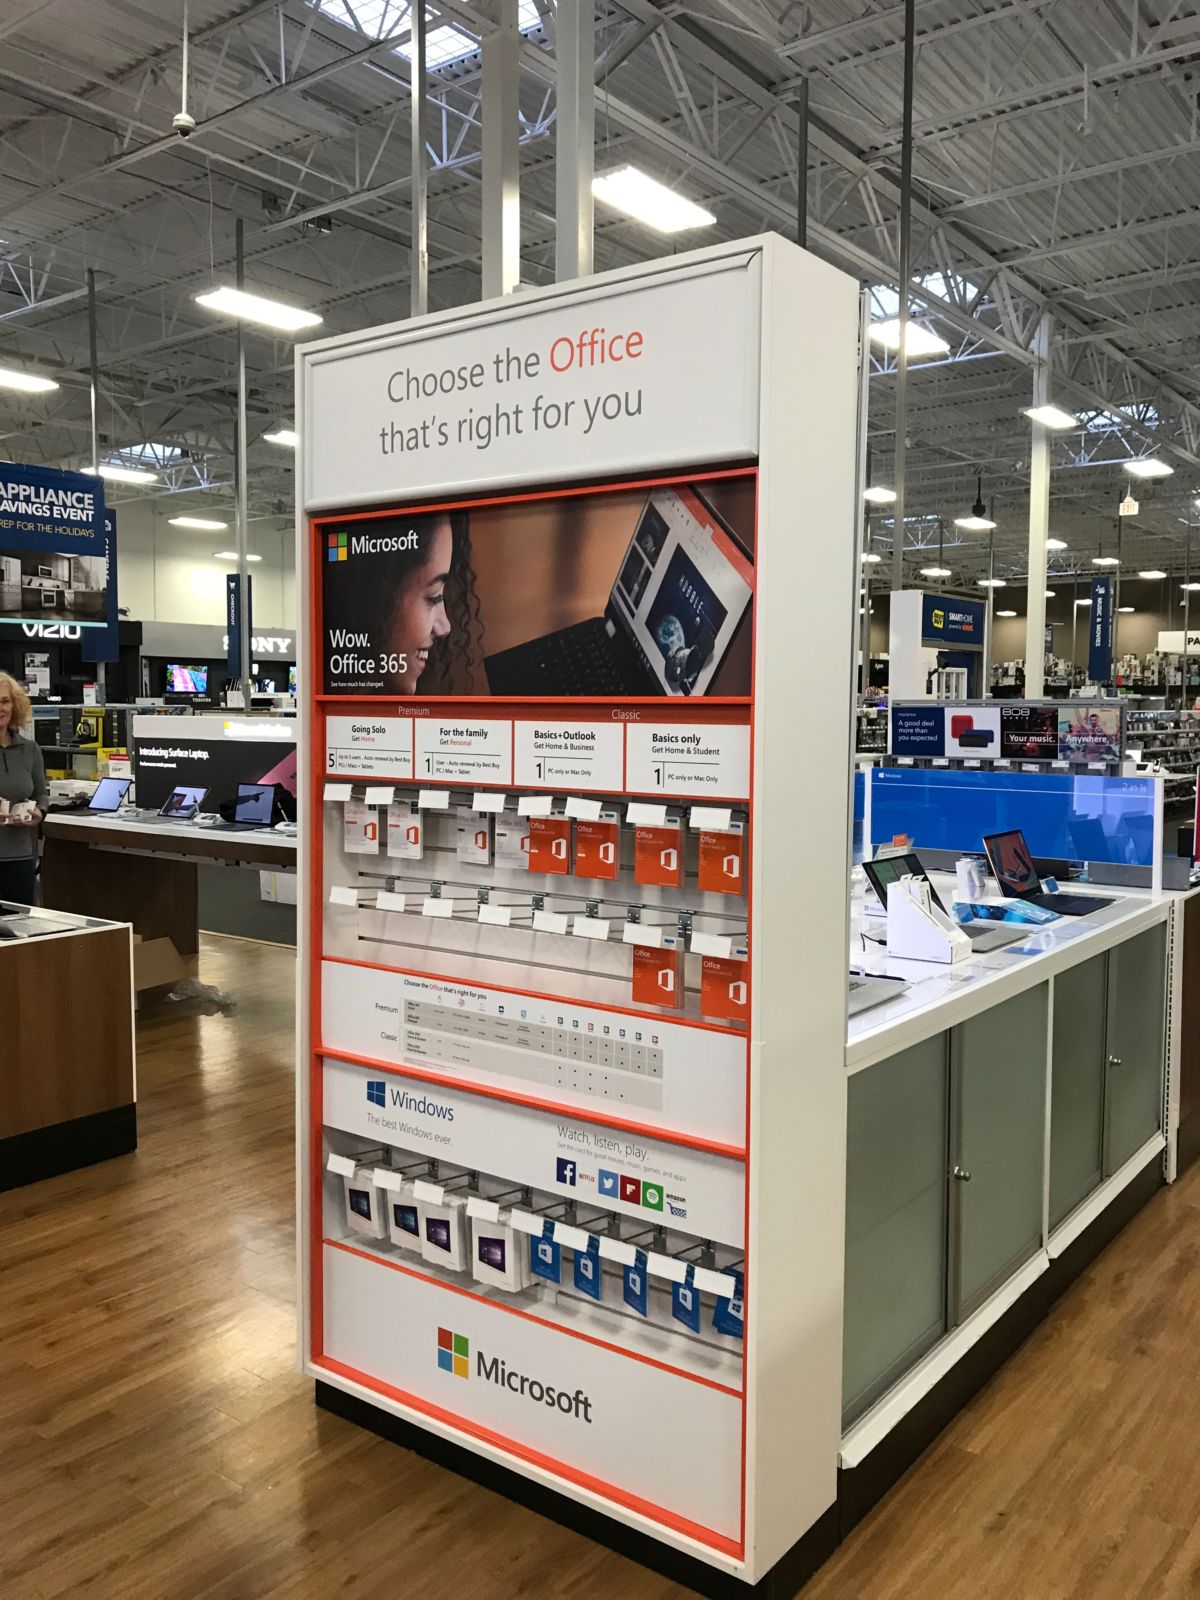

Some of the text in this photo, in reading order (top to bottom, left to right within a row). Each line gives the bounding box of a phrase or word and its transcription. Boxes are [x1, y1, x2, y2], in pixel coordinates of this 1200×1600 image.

[387, 327, 644, 403] Choose the Office
[379, 389, 642, 455] that's right for you
[0, 482, 95, 510] APPLIANCE
[0, 500, 95, 523] AVINGS EVENT
[0, 518, 95, 539] REP FOR THE HOLIDAYS
[351, 529, 419, 555] Microsoft
[21, 622, 81, 640] VIZIO
[329, 628, 371, 648] Wow.
[330, 653, 408, 674] Office 365
[398, 706, 430, 716] Premium
[611, 708, 641, 720] Classic
[351, 724, 386, 735] Going Solo
[904, 720, 920, 728] good
[439, 727, 489, 740] For the family
[534, 730, 596, 741] Basics+Outlook
[652, 733, 701, 746] Basics only
[910, 734, 938, 742] expected
[1009, 734, 1056, 743] Your music.
[439, 738, 472, 746] Get Personal
[533, 741, 544, 749] Get
[545, 742, 563, 750] Home
[569, 743, 595, 751] Business
[139, 747, 169, 759] Introducing
[168, 747, 189, 758] Surface
[651, 745, 720, 756] Get Home & Student
[328, 753, 335, 768] 5
[425, 757, 431, 773] 1
[535, 762, 542, 779] 1
[580, 769, 592, 777] Only
[654, 768, 661, 785] 1
[675, 774, 687, 782] only
[705, 775, 719, 784] Only
[530, 822, 546, 830] Office
[577, 825, 593, 833] Office
[636, 830, 653, 839] Office
[700, 835, 717, 844] Office
[634, 949, 651, 958] Office
[703, 960, 721, 970] Office
[403, 978, 421, 987] Choose
[476, 993, 487, 1001] you
[375, 1002, 399, 1014] Premium
[380, 1031, 398, 1042] Classic
[390, 1088, 454, 1122] Windows
[367, 1112, 381, 1126] The
[381, 1116, 398, 1131] best
[398, 1121, 433, 1141] Windows
[557, 1125, 650, 1163] Watch, listen, play.
[476, 1350, 593, 1424] Microsoft
